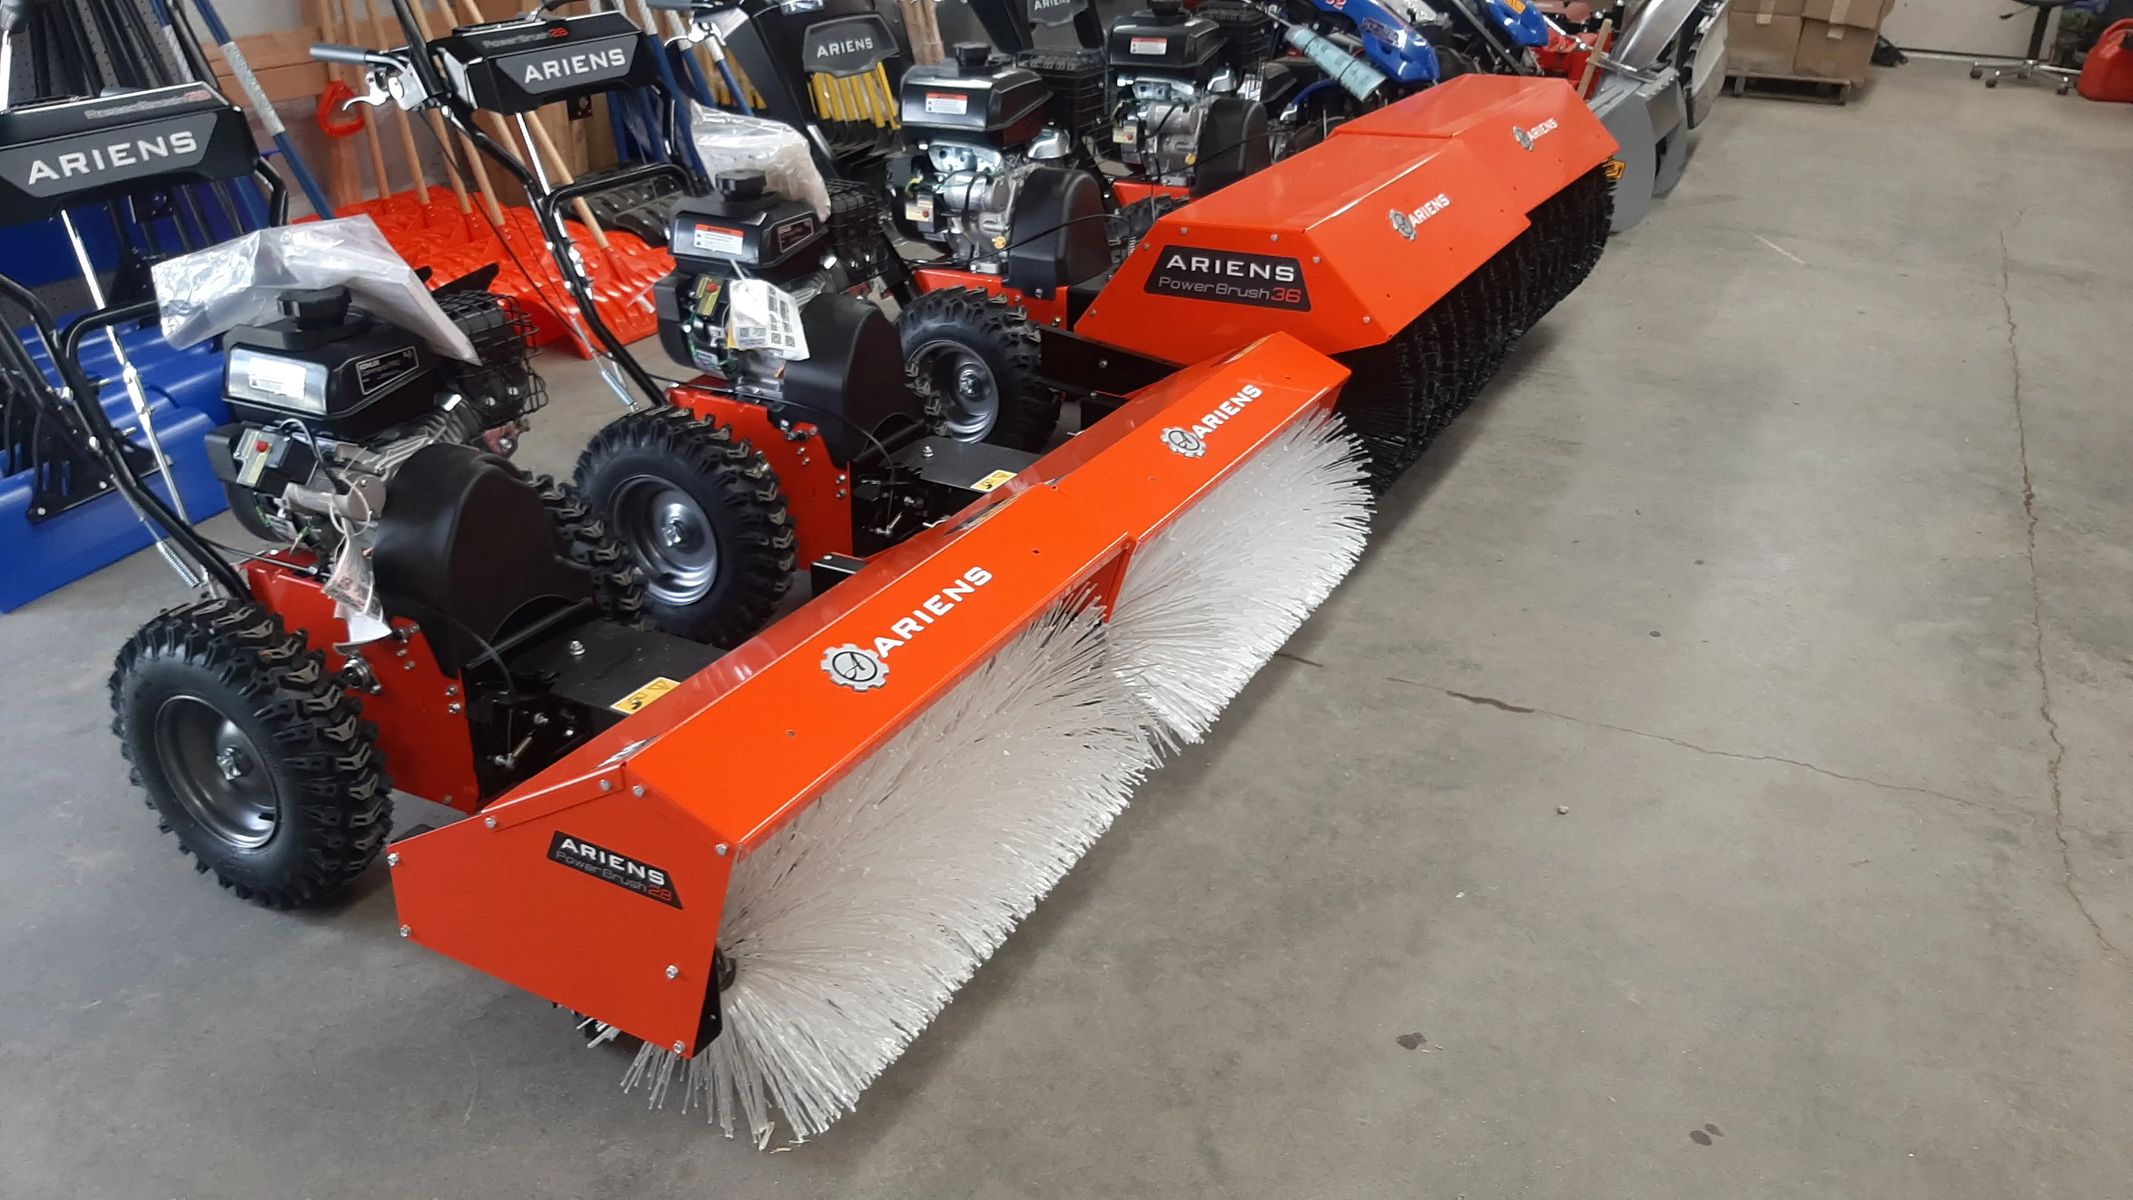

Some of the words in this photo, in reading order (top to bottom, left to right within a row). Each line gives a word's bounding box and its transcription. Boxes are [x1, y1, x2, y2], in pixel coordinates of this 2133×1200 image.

[816, 37, 874, 58] ARIENS
[525, 48, 626, 84] ARIENS
[1526, 118, 1558, 141] ARIENS
[28, 131, 197, 185] ARIENS
[1408, 193, 1451, 227] ARIENS
[1166, 255, 1295, 282] ARIENS
[1192, 384, 1263, 440] ARIENS
[874, 566, 993, 658] ARIENS
[561, 838, 665, 886] ARIENS
